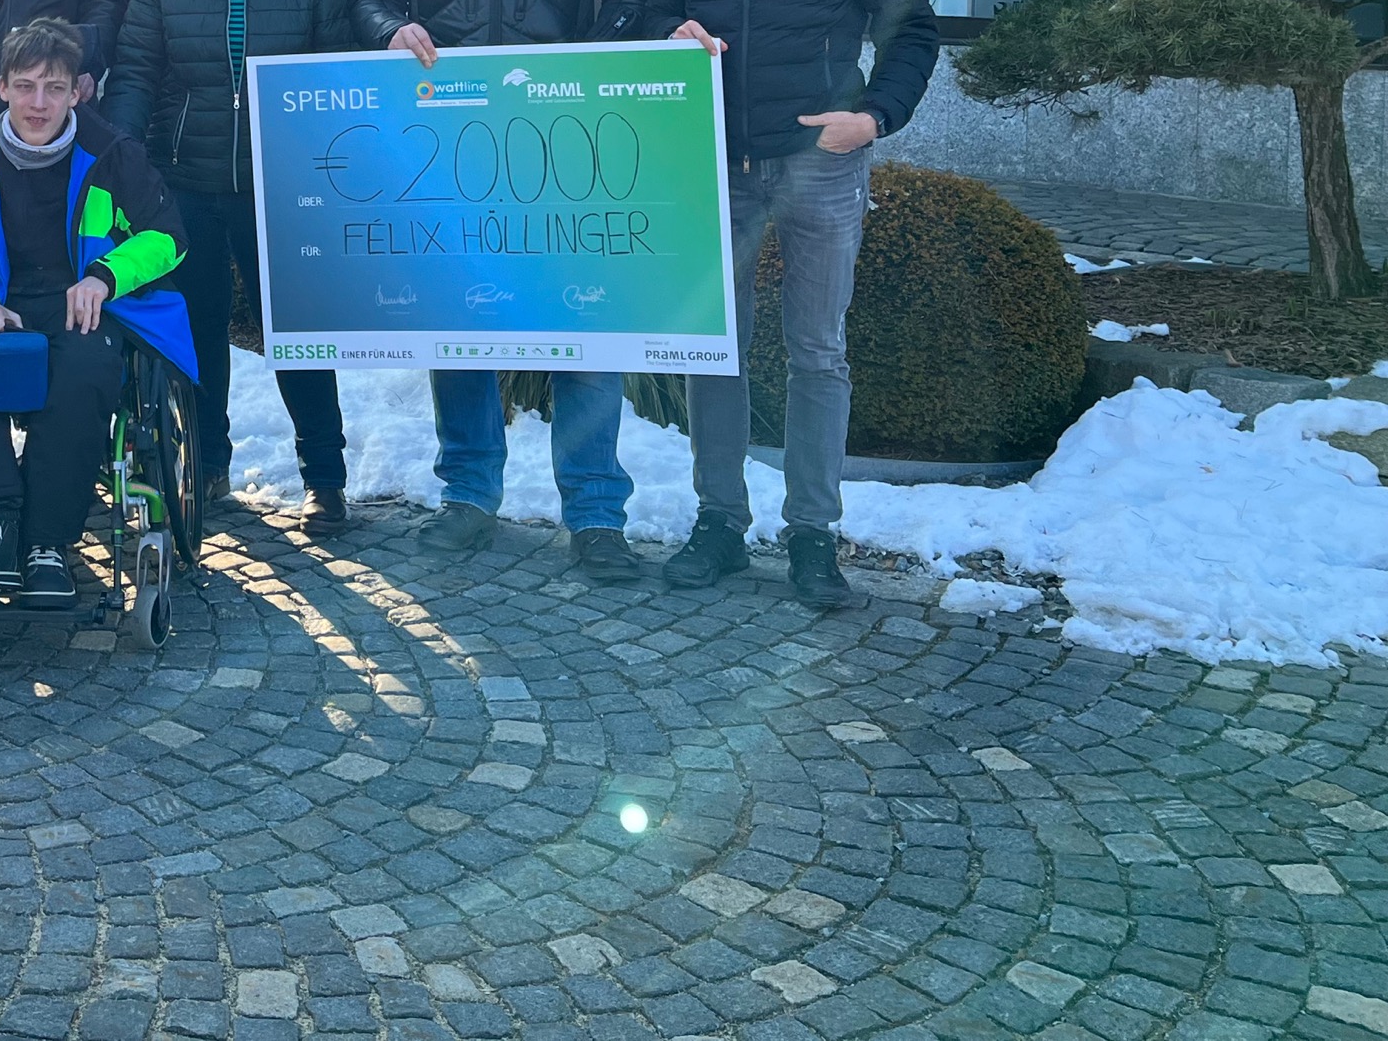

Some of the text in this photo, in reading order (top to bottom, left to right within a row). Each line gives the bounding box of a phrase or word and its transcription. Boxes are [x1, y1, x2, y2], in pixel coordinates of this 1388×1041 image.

[434, 81, 488, 93] wattline
[527, 82, 585, 97] PRAML
[598, 82, 687, 97] CITYWATT
[282, 87, 380, 112] SPENDE
[297, 195, 325, 207] ÜBER:
[463, 210, 655, 255] HÖLLINGER
[300, 245, 321, 257] FÜR:
[273, 344, 416, 359] BESSER EINER FÜR ALLES.
